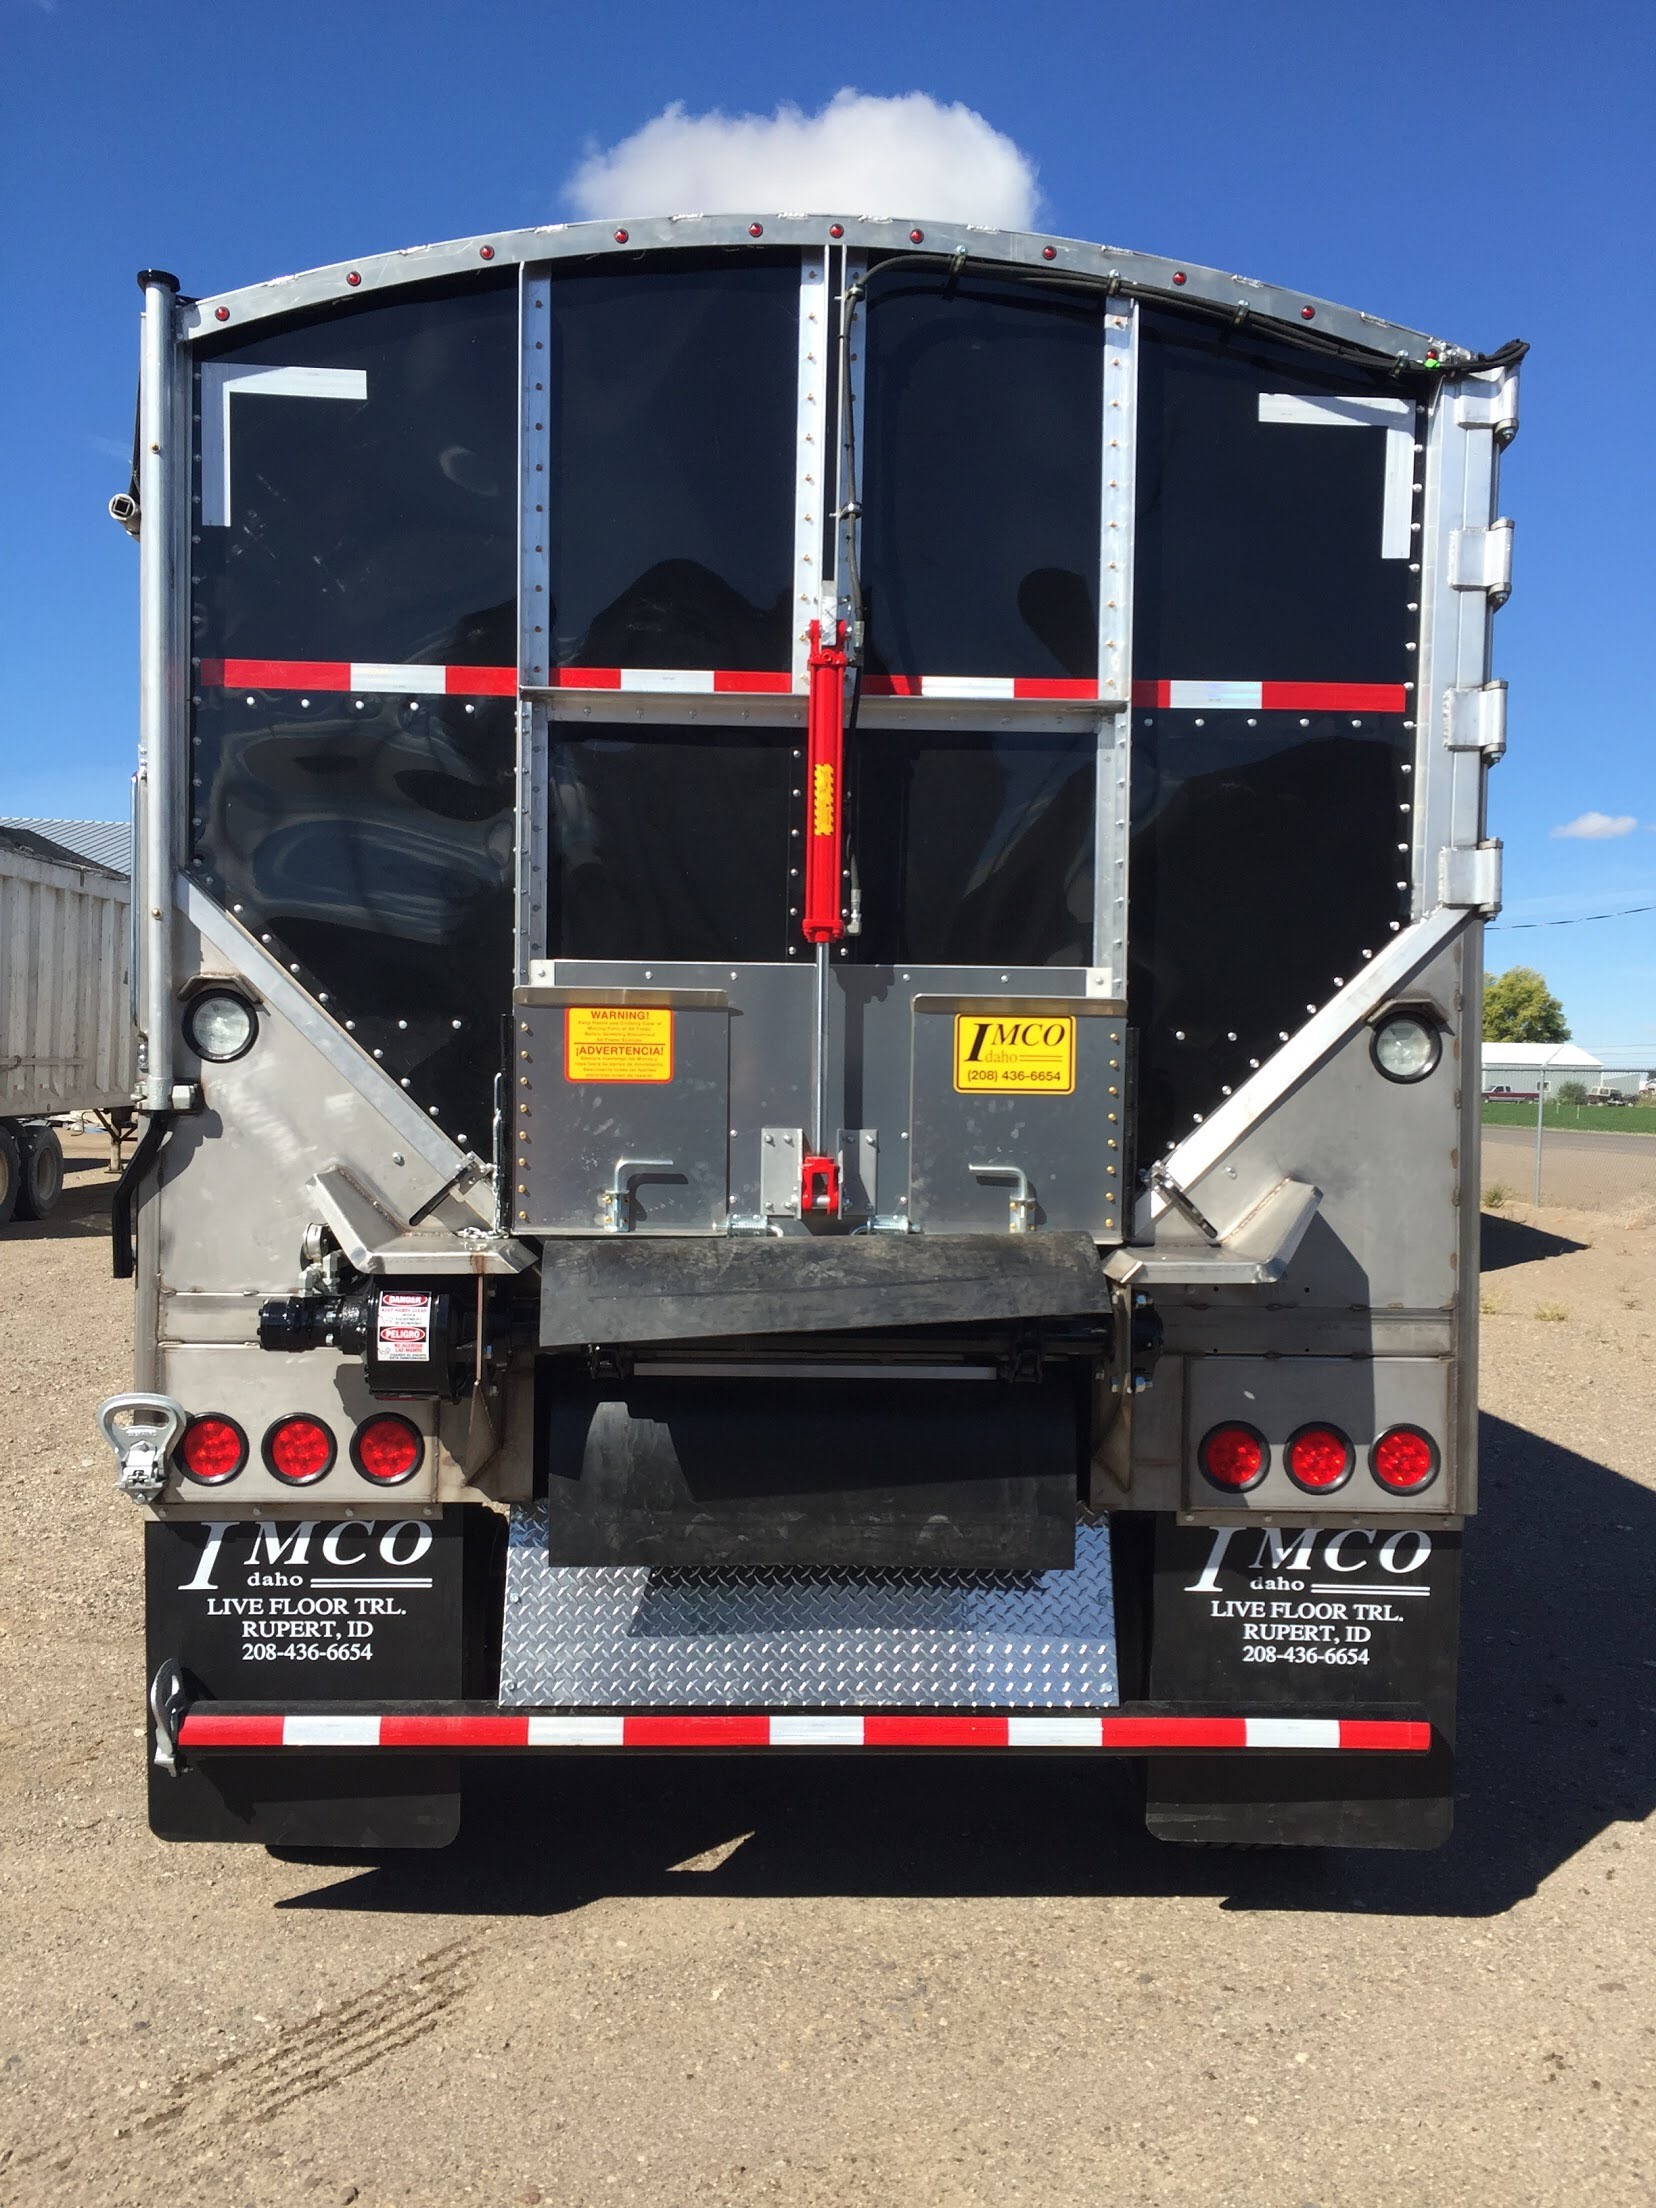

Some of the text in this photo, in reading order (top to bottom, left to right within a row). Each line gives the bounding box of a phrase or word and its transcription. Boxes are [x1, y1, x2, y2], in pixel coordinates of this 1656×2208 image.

[591, 1010, 650, 1020] WARNING!
[576, 1046, 664, 1056] ¡ADVERTENCIA!
[964, 1023, 1066, 1062] IMCO
[968, 1070, 1061, 1082] (208) 436-6654
[385, 1330, 420, 1338] PELIGRO
[178, 1520, 433, 1590] IMCO
[1184, 1526, 1432, 1592] IMCO
[207, 1598, 407, 1615] LIVE FLOOR TRL.
[1211, 1601, 1404, 1622] LIVE FLOOR TRL.
[242, 1620, 374, 1640] RUPERT, ID
[1243, 1623, 1372, 1644] RUPERT, ID
[242, 1643, 373, 1661] 208-436-6654
[1242, 1645, 1370, 1665] 208-436-6654
